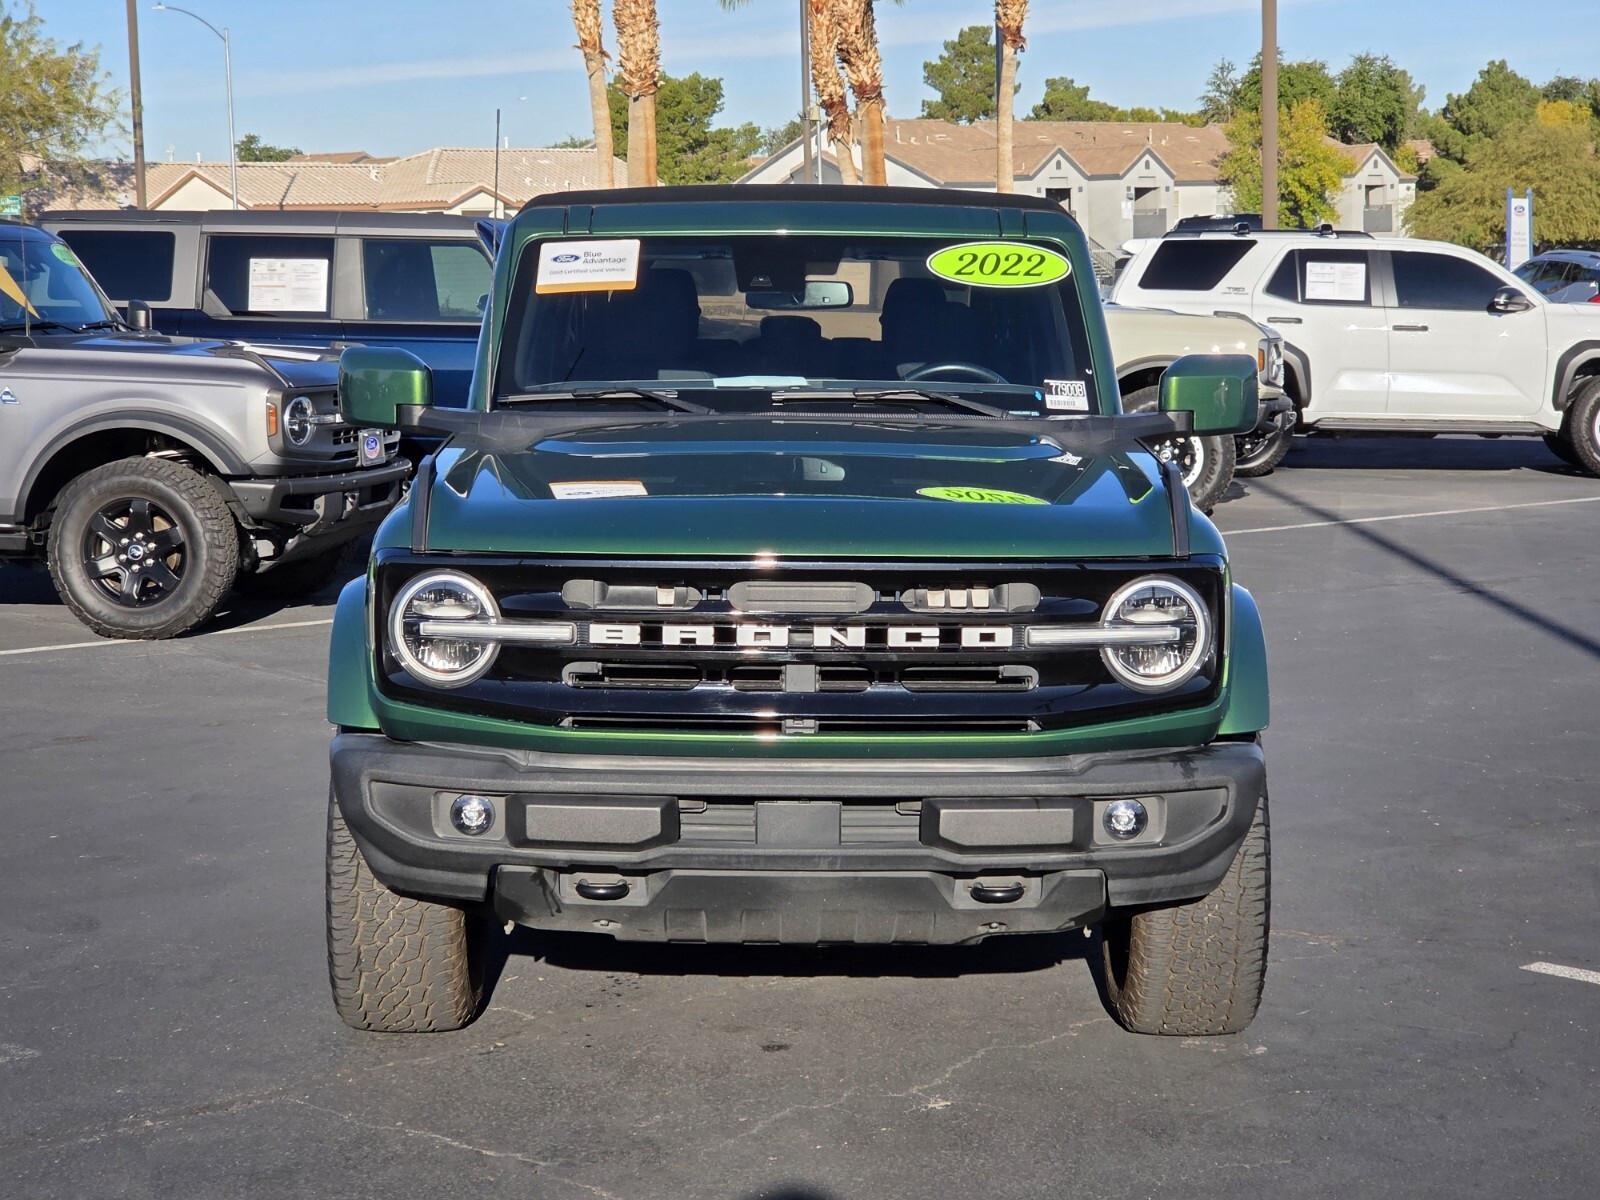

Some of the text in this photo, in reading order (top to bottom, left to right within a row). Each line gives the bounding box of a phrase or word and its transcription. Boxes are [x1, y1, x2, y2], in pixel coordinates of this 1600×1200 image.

[582, 257, 627, 265] Advantage
[953, 252, 1046, 277] 2022
[589, 623, 1014, 649] BRONCO
